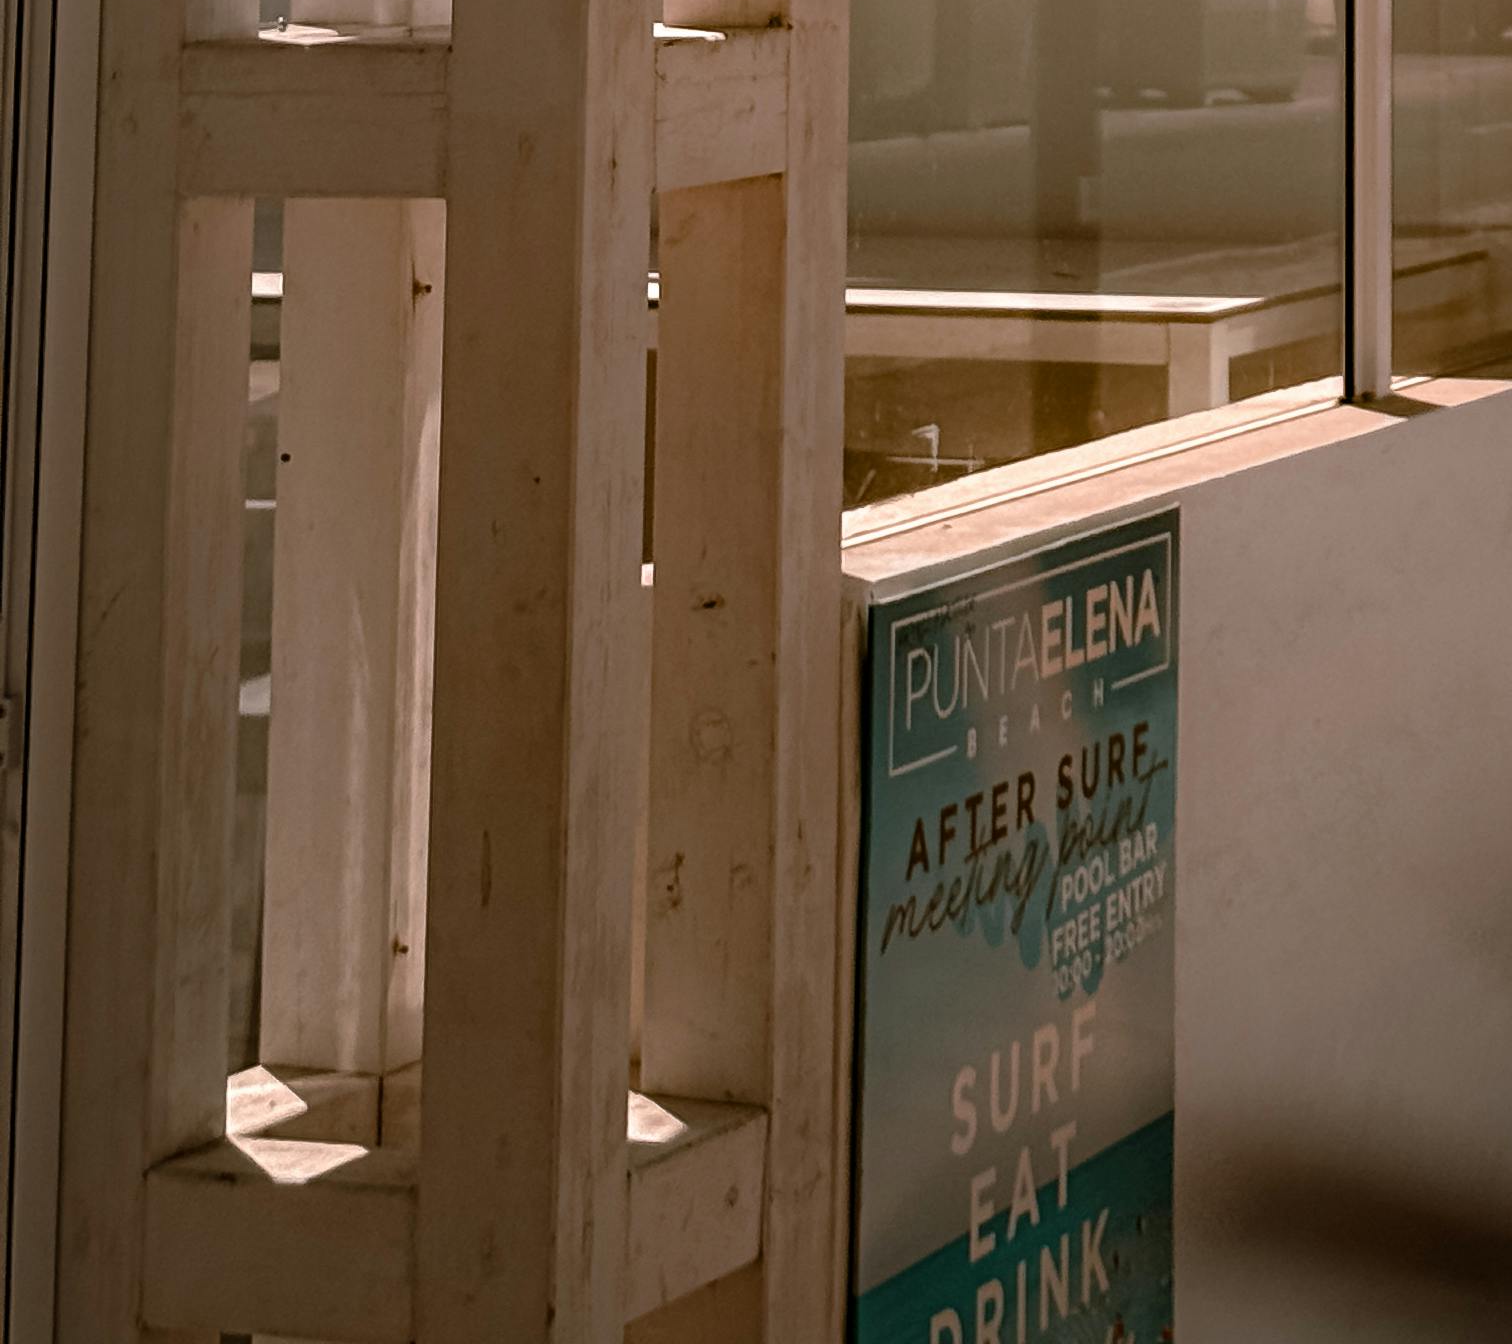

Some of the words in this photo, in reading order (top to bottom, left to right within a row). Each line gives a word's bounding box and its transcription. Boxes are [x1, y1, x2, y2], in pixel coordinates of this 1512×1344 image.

[966, 678, 1104, 759] BEACH
[905, 771, 1036, 882] AFTER
[1057, 720, 1149, 810] SURF
[1052, 903, 1101, 966] FREE
[1105, 861, 1168, 933] ENTRY
[1061, 850, 1116, 912] POOL
[1119, 821, 1158, 876] BAR
[951, 1000, 1098, 1155] SURF
[968, 1120, 1078, 1264] EAT
